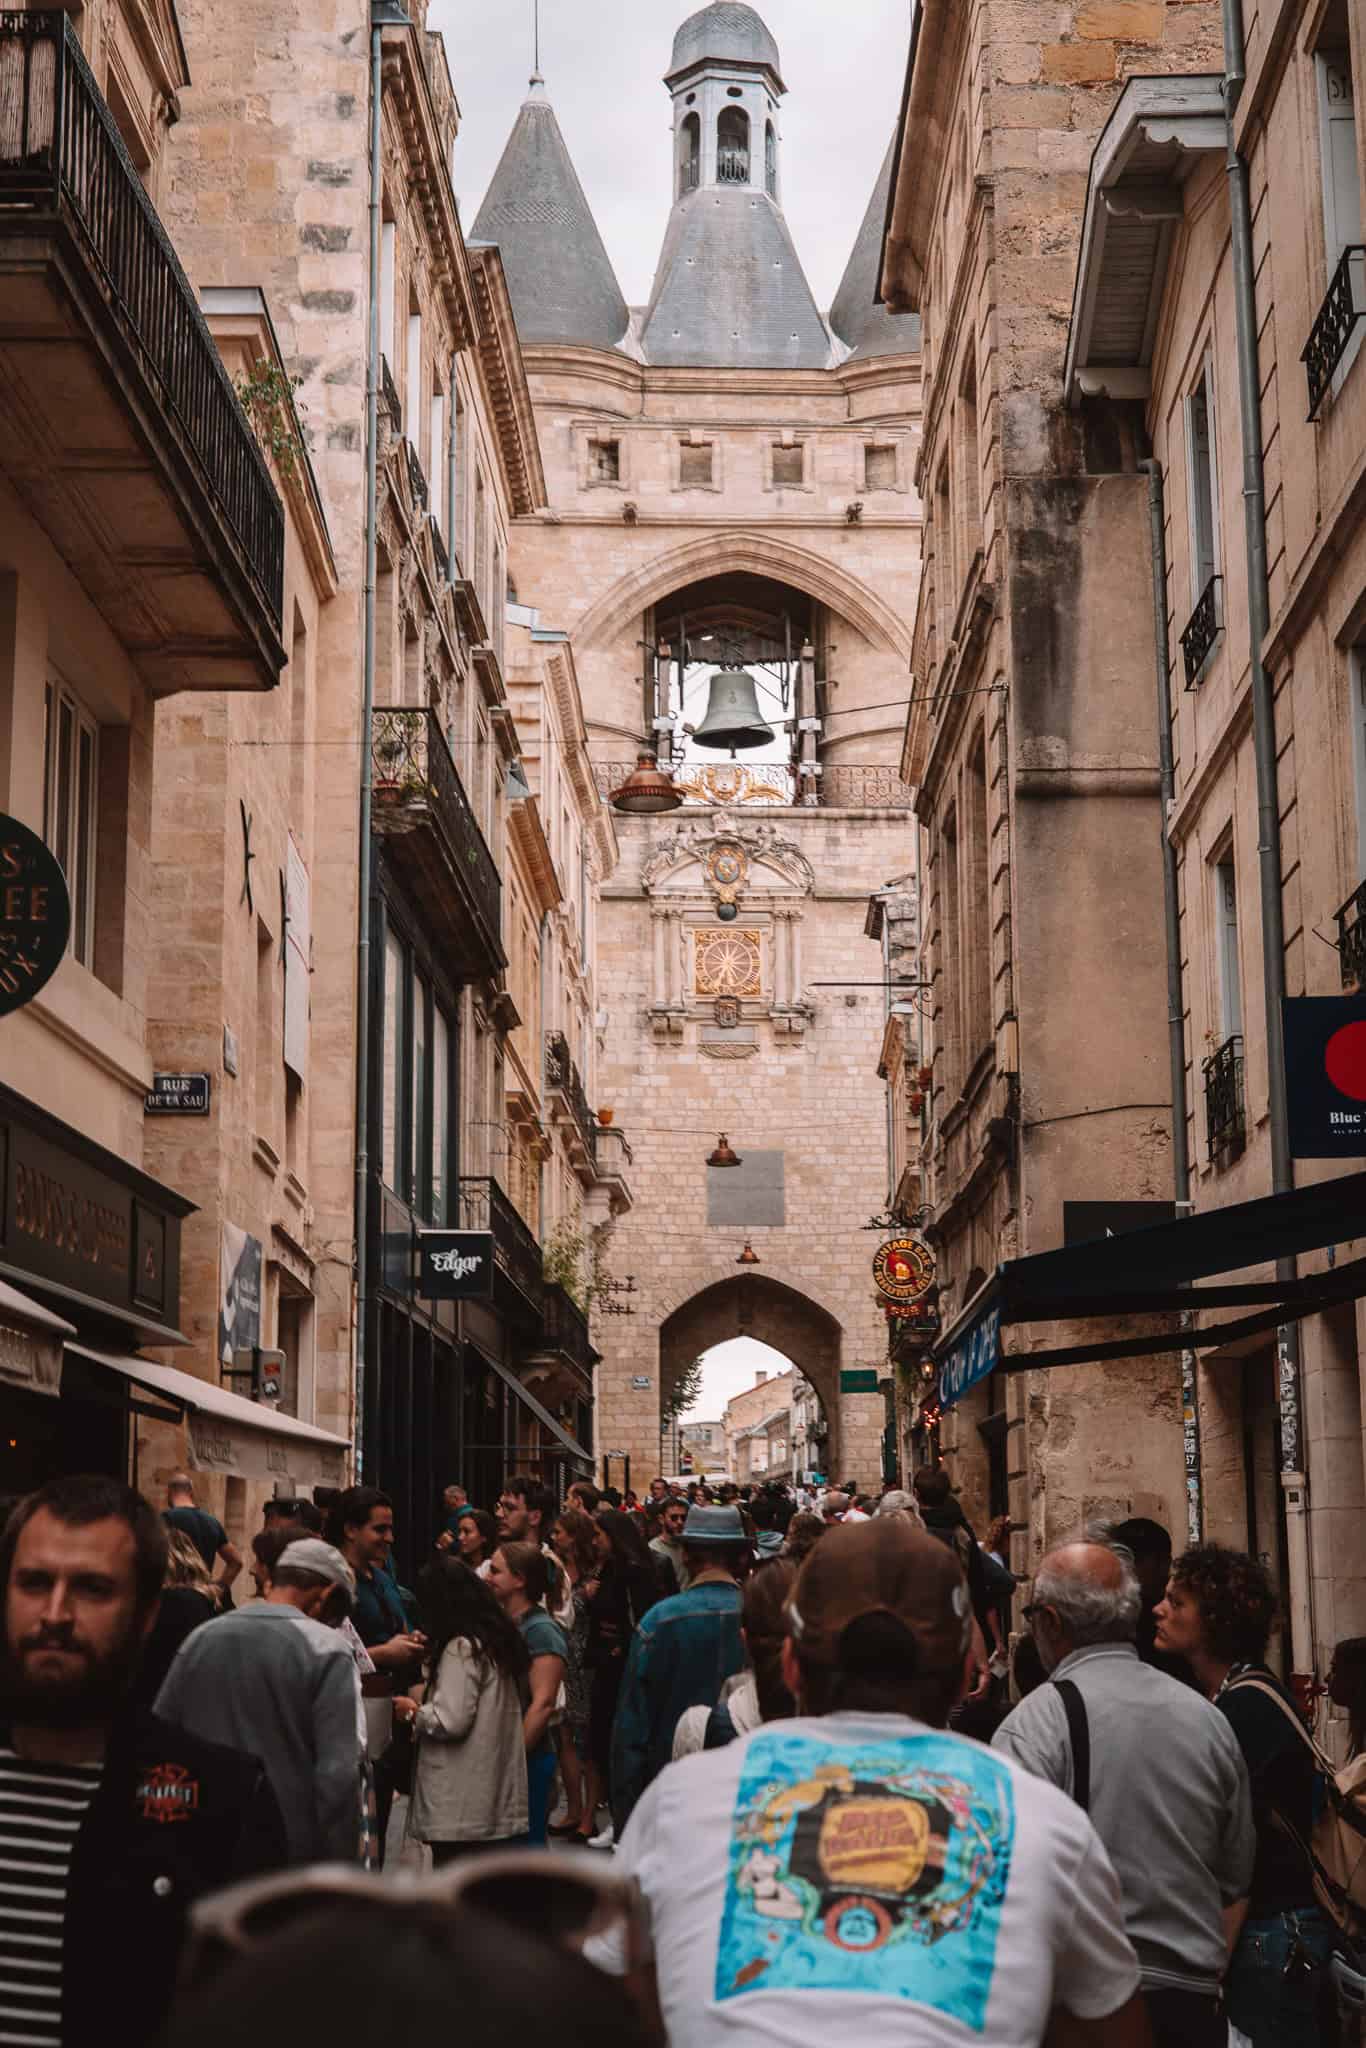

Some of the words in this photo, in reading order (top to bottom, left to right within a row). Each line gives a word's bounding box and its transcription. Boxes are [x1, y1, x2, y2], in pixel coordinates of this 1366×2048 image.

[163, 1079, 191, 1091] RUE
[148, 1095, 161, 1106] DE
[183, 1095, 203, 1107] SAU
[874, 1240, 913, 1266] VINTAGE
[914, 1245, 930, 1266] BAR
[430, 1248, 483, 1280] Edgar
